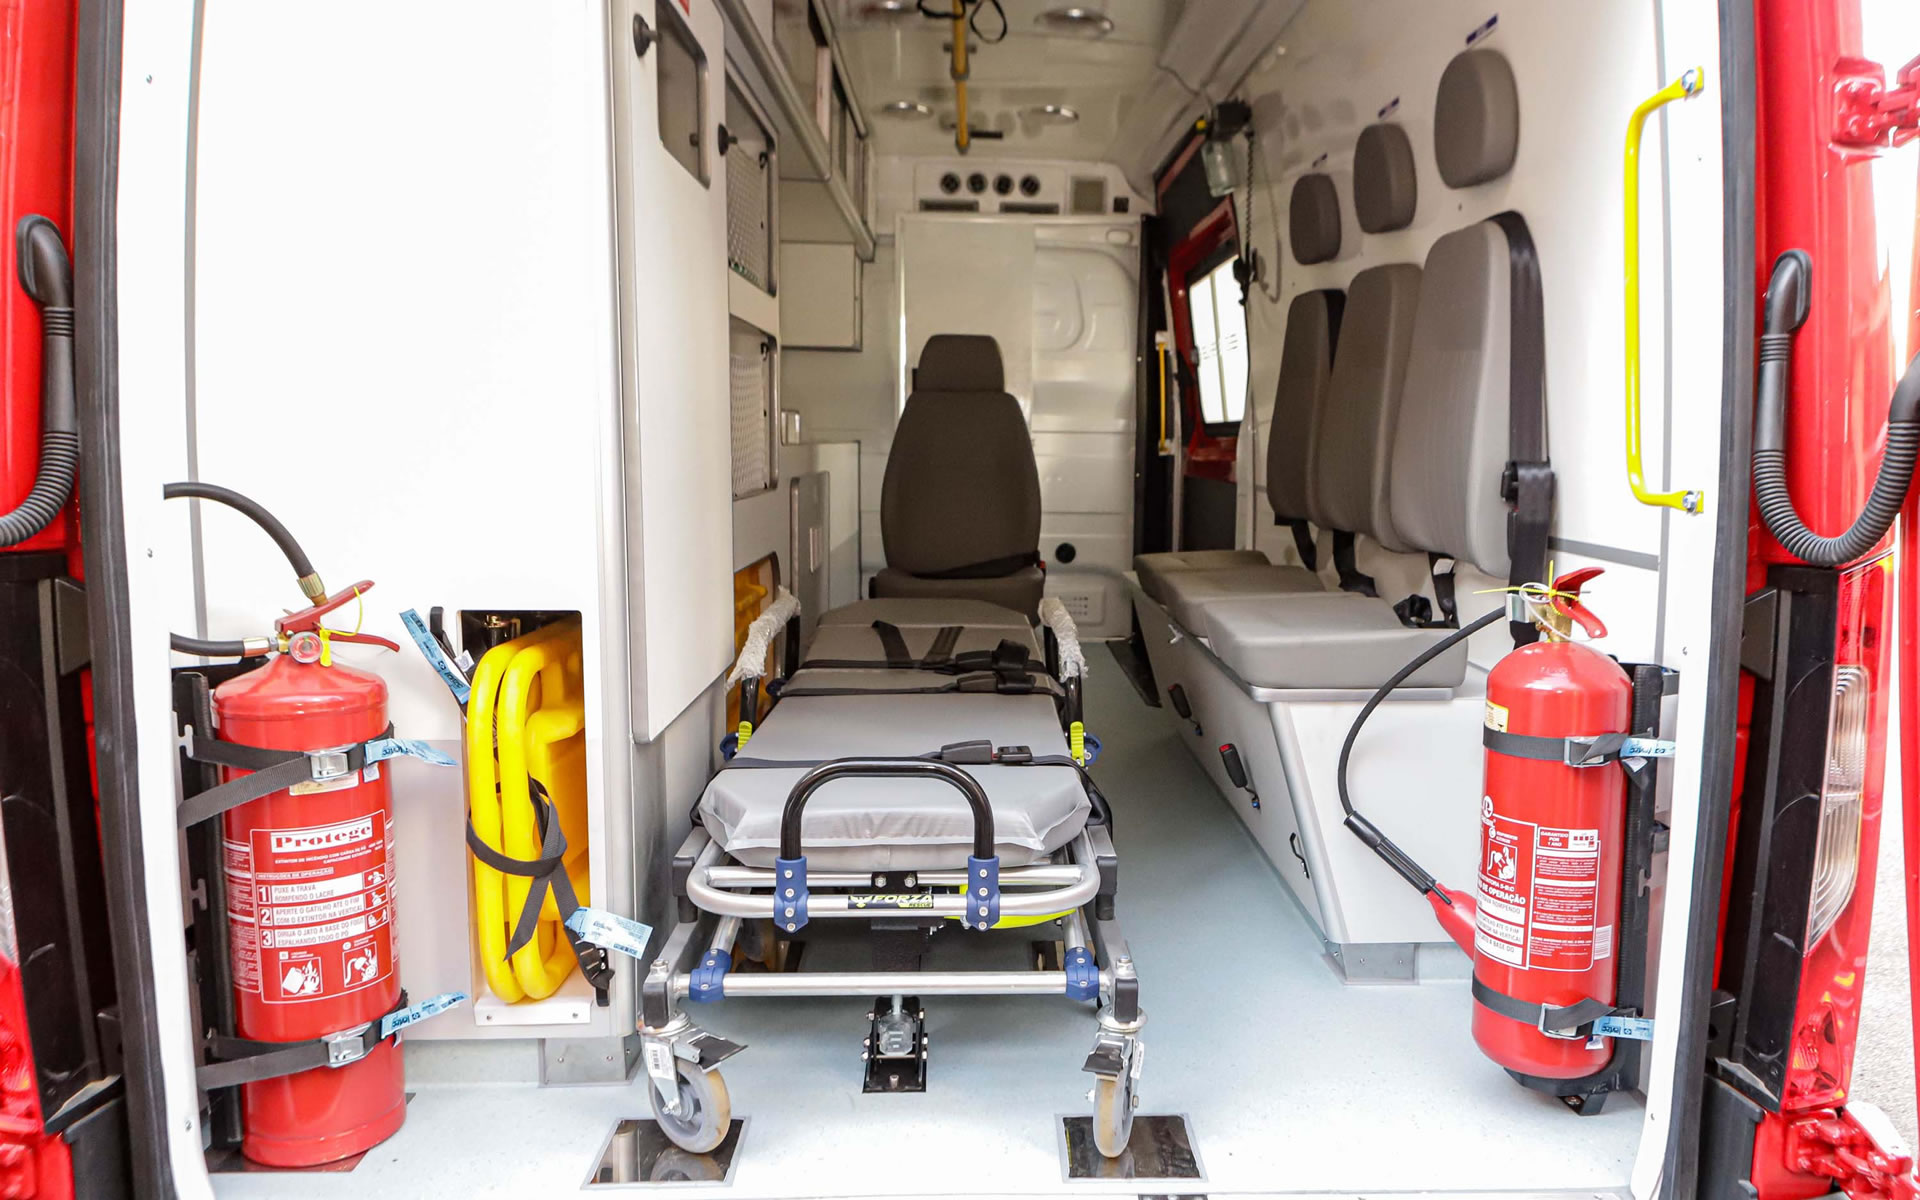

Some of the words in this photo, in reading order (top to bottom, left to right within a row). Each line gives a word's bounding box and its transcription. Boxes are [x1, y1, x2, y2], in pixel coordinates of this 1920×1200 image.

[275, 827, 371, 848] Protege
[259, 887, 268, 902] 1
[297, 884, 316, 892] TRAVA
[275, 893, 308, 902] ROMPENDO
[315, 889, 334, 899] LACRE
[872, 895, 932, 903] FORZA
[1488, 887, 1526, 905] OPERAÇÃO
[261, 909, 270, 923] 2
[276, 907, 298, 916] APERTE
[306, 903, 332, 913] GATILHO
[276, 917, 290, 925] COM
[298, 914, 327, 923] EXTINTOR
[304, 928, 318, 936] JATO
[325, 924, 339, 933] BASE
[341, 921, 350, 929] DO
[262, 931, 271, 946] 3
[278, 936, 316, 946] ESPALHANDO
[318, 933, 334, 943] TODO
